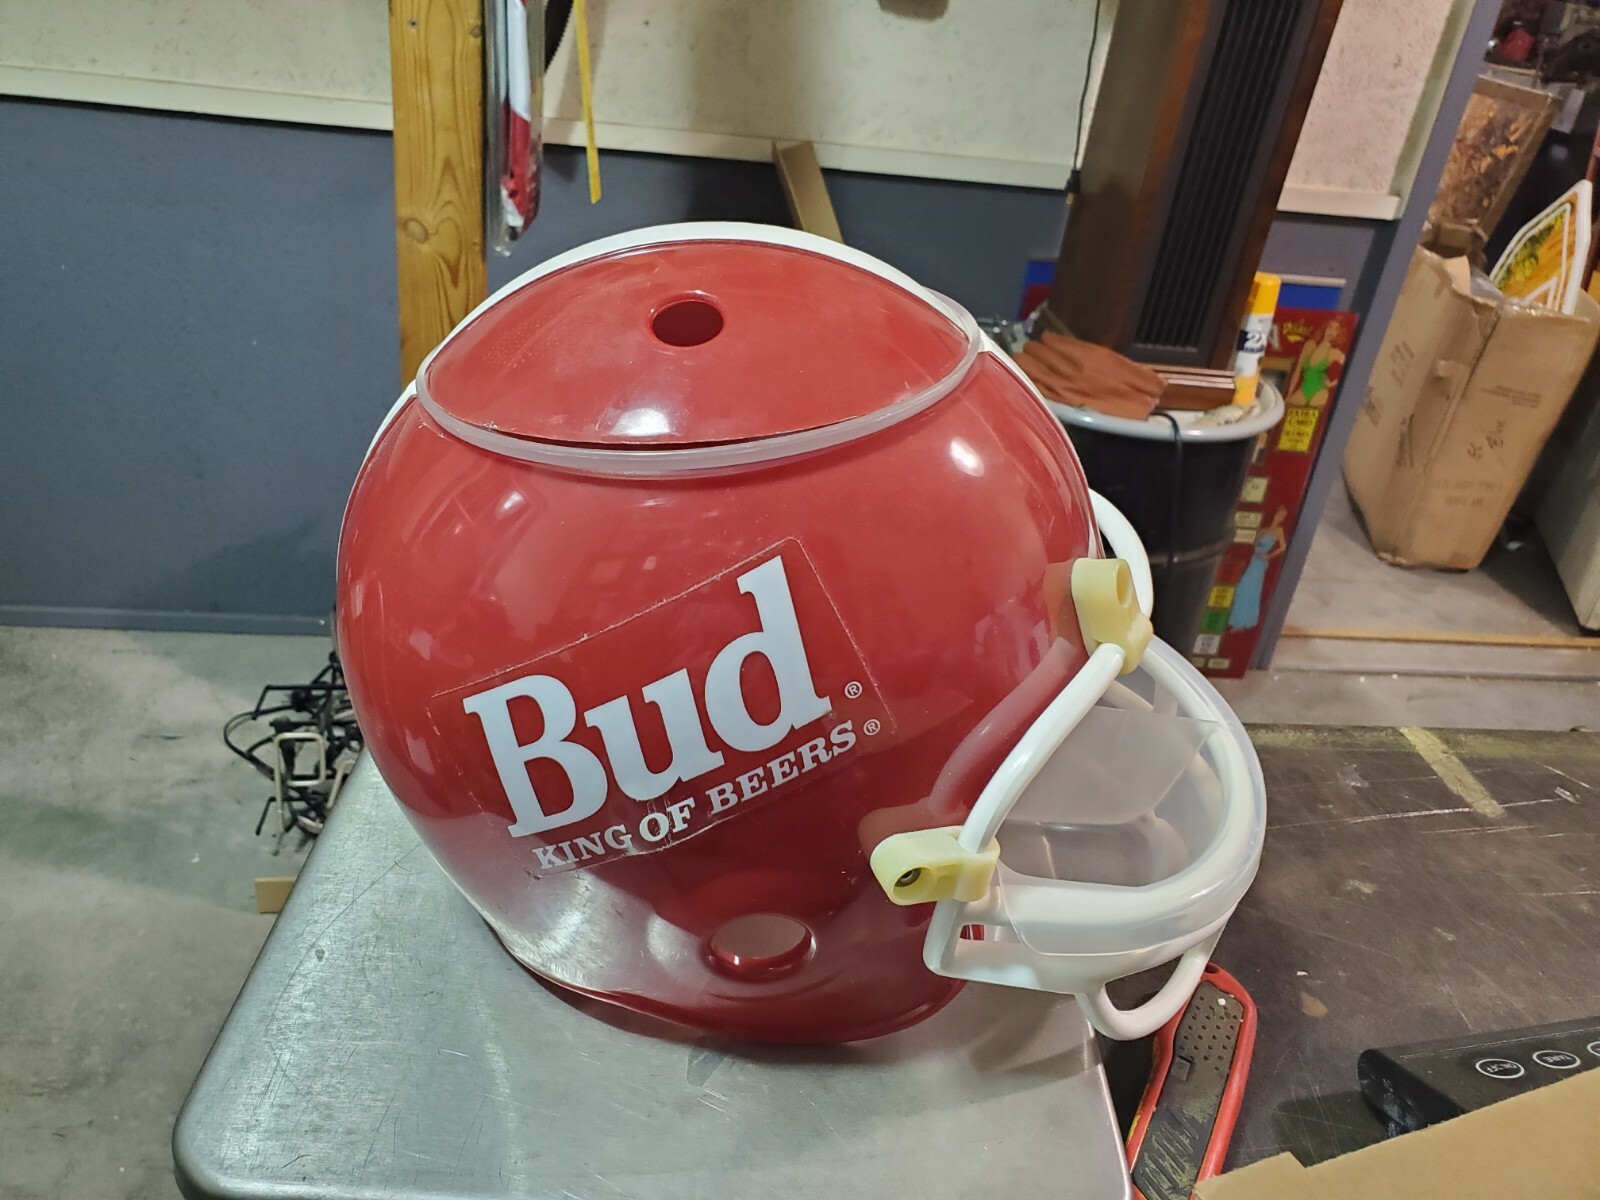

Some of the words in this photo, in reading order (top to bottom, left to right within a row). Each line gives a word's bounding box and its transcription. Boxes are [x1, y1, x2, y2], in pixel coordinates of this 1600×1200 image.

[462, 555, 832, 838] Bud
[532, 824, 633, 869] KING
[638, 797, 695, 842] OF
[705, 720, 856, 816] BEERS
